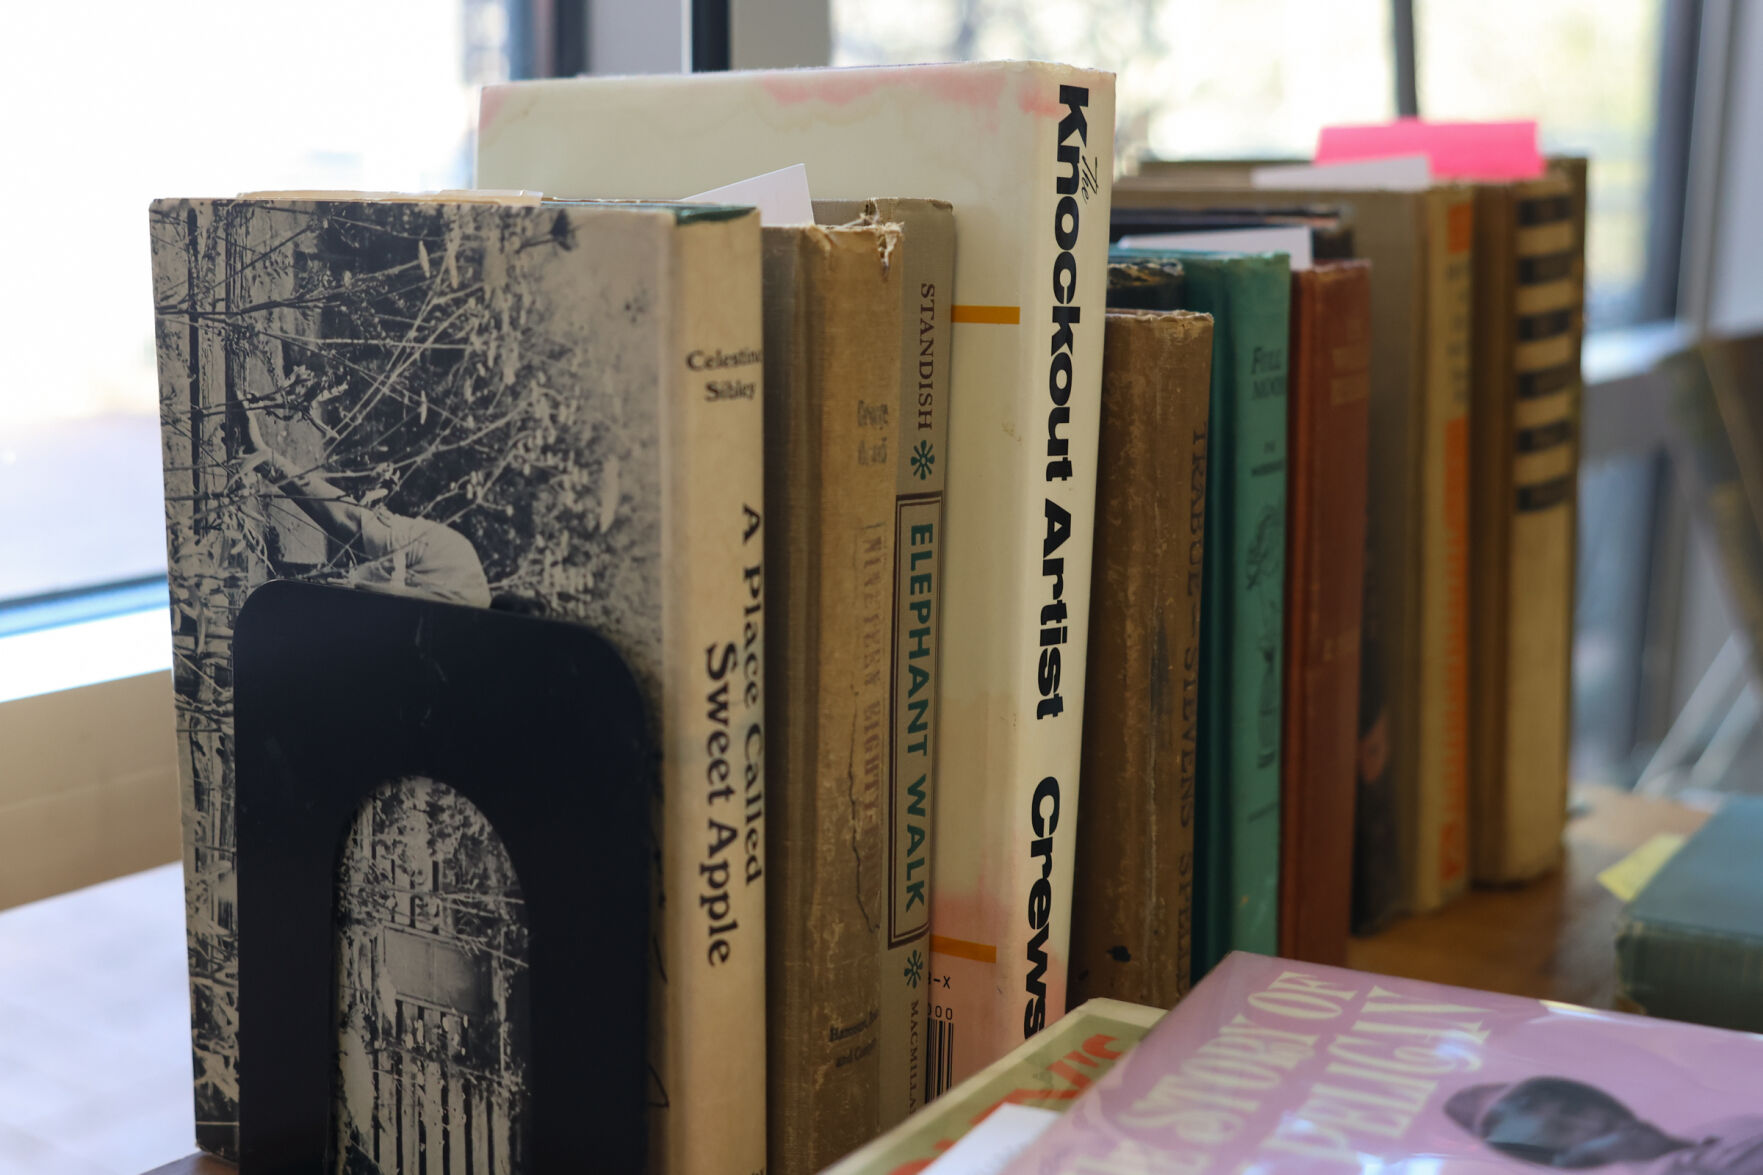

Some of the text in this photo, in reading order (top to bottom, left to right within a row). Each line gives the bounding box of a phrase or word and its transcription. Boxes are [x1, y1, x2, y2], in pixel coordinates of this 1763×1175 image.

[918, 283, 936, 431] STANDISH
[1081, 155, 1099, 206] The
[742, 503, 763, 888] A Place Called
[905, 523, 933, 913] ELEPHANT WALK
[1024, 84, 1090, 1040] Knockout Artist Crews
[699, 641, 739, 968] Sweet Apple
